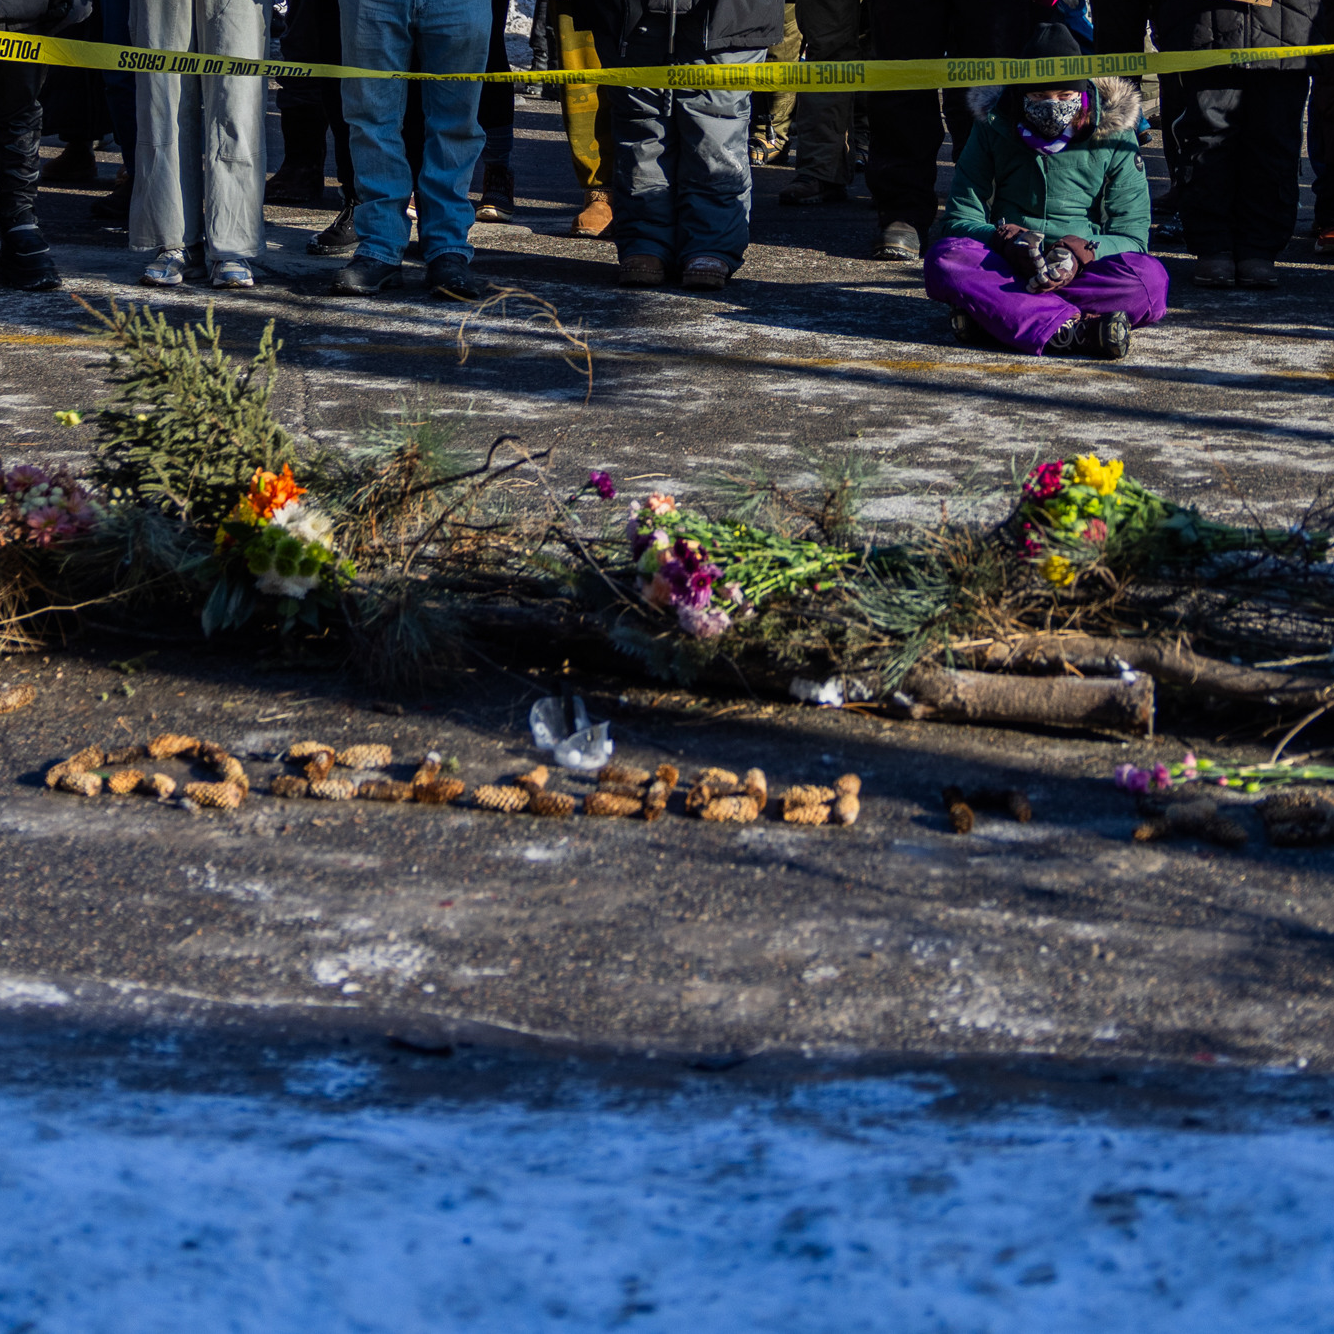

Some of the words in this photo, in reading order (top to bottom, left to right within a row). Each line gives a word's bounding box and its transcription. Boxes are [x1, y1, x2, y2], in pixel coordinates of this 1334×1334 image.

[118, 51, 166, 72] CROSS
[168, 56, 200, 73] NOT
[203, 59, 224, 74] DO
[229, 61, 263, 76] LINE
